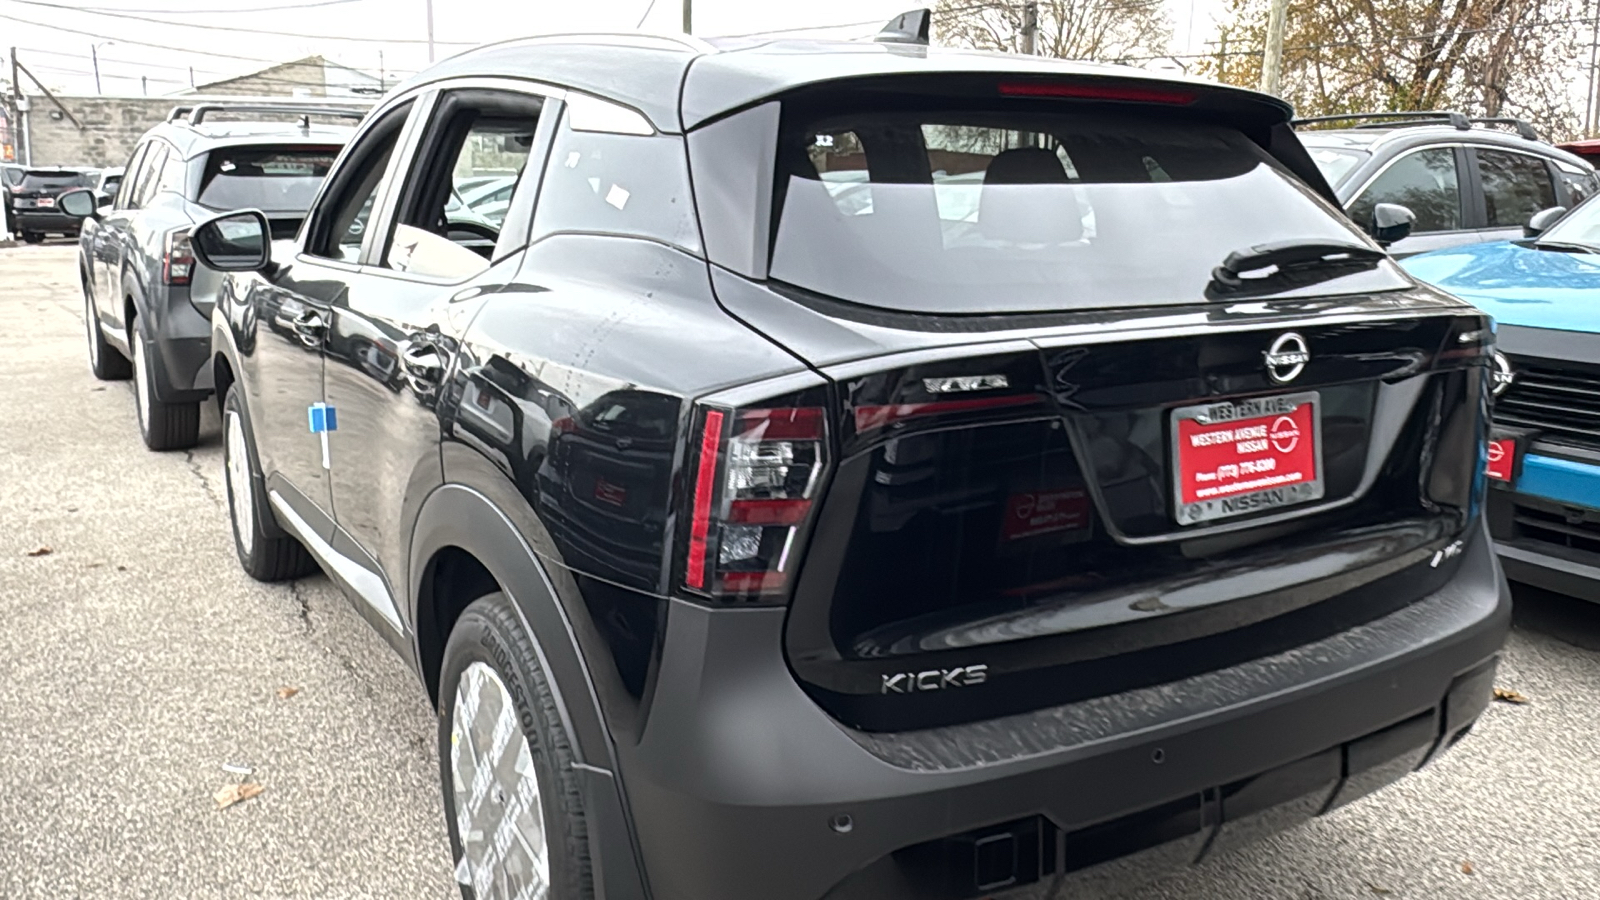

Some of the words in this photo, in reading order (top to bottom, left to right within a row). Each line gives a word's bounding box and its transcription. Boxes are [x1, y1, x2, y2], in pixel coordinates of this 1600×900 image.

[1264, 354, 1309, 366] NISSAN
[1209, 401, 1261, 420] WESTERN
[1190, 430, 1234, 447] WESTERN
[1234, 425, 1268, 441] AVENUE
[1236, 440, 1269, 454] NISSAN
[1221, 488, 1284, 514] NISSAN
[881, 663, 988, 695] KICKS
